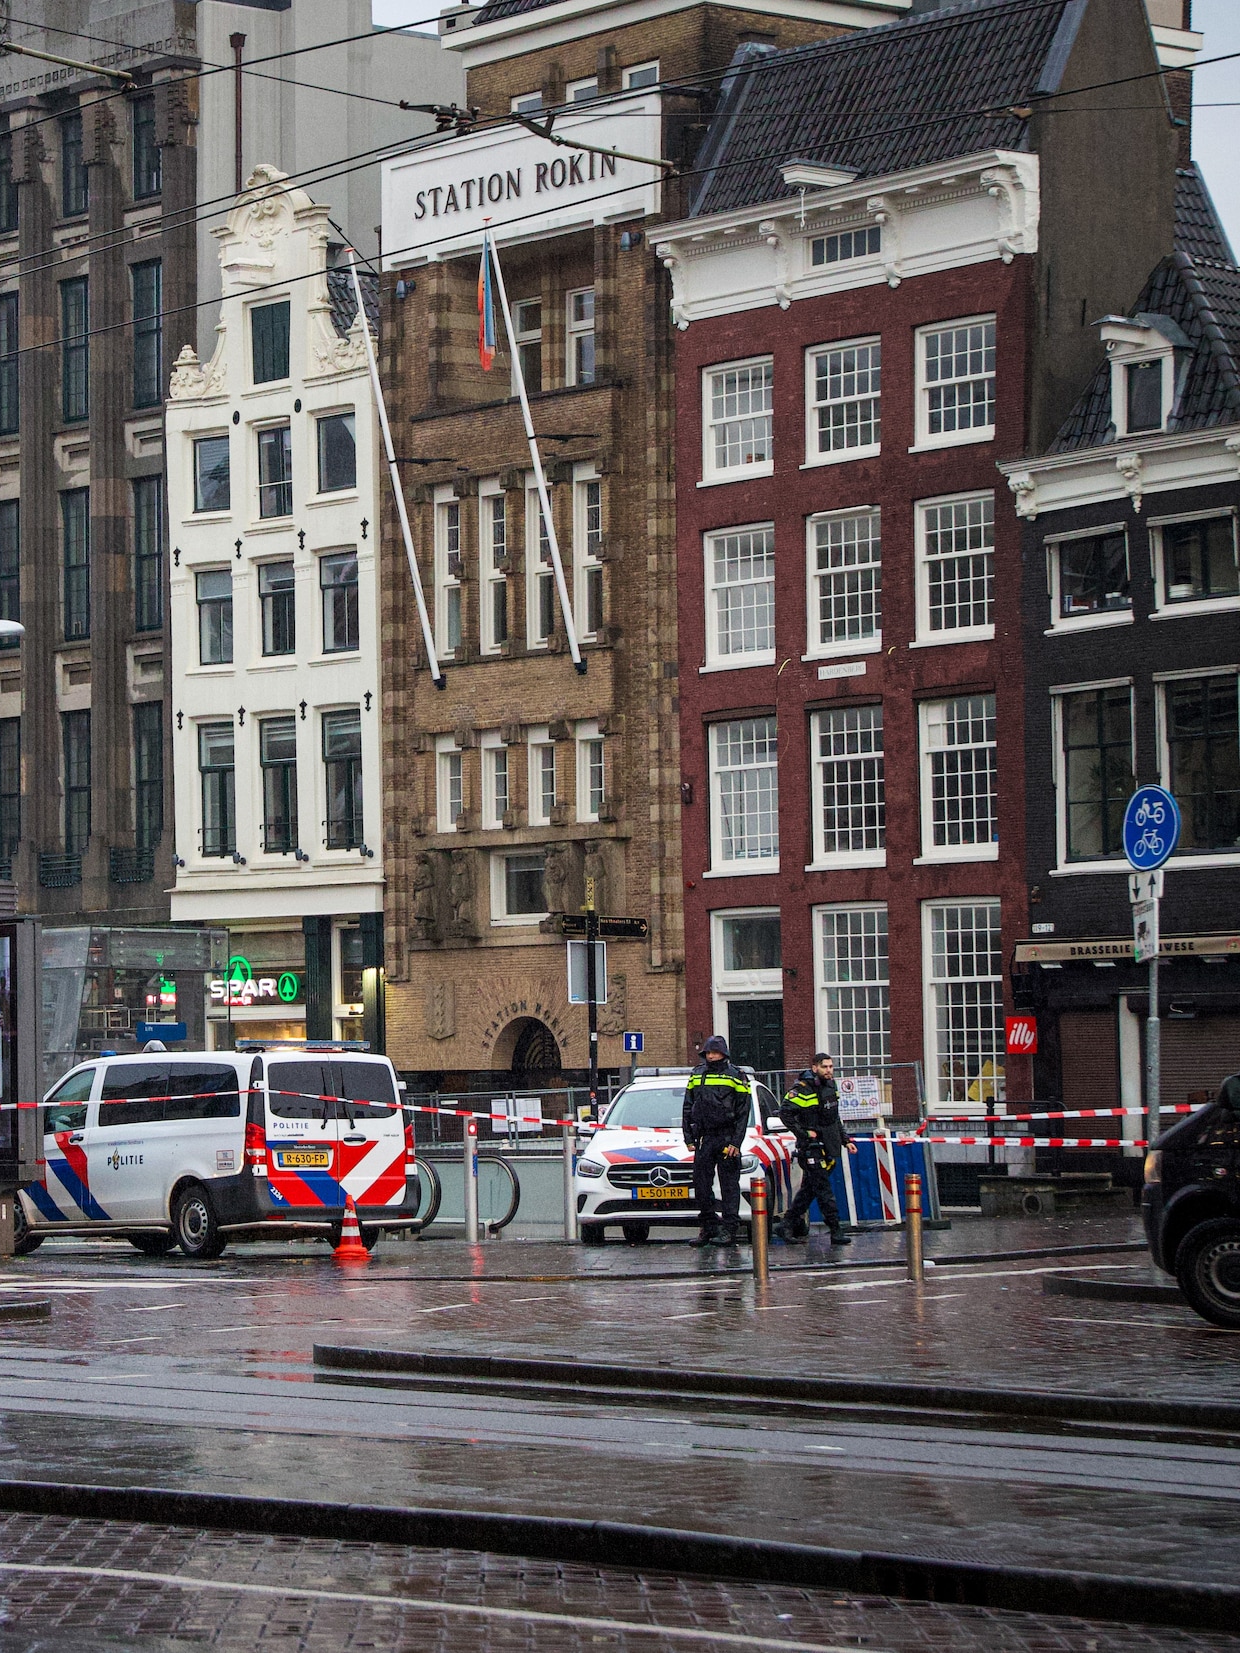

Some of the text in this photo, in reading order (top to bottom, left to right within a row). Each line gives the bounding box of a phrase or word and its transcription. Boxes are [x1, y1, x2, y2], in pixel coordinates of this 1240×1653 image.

[414, 145, 616, 220] STATION ROKIN
[820, 664, 865, 677] HARDENBERG
[1070, 944, 1131, 956] BRASSERIE
[210, 978, 278, 998] SPAR
[481, 1000, 569, 1050] STATION ROKIN
[1009, 1022, 1035, 1050] illy
[273, 1122, 309, 1130] POLITIE
[286, 1154, 325, 1164] R-630-FP
[640, 1188, 684, 1198] L-501-RR
